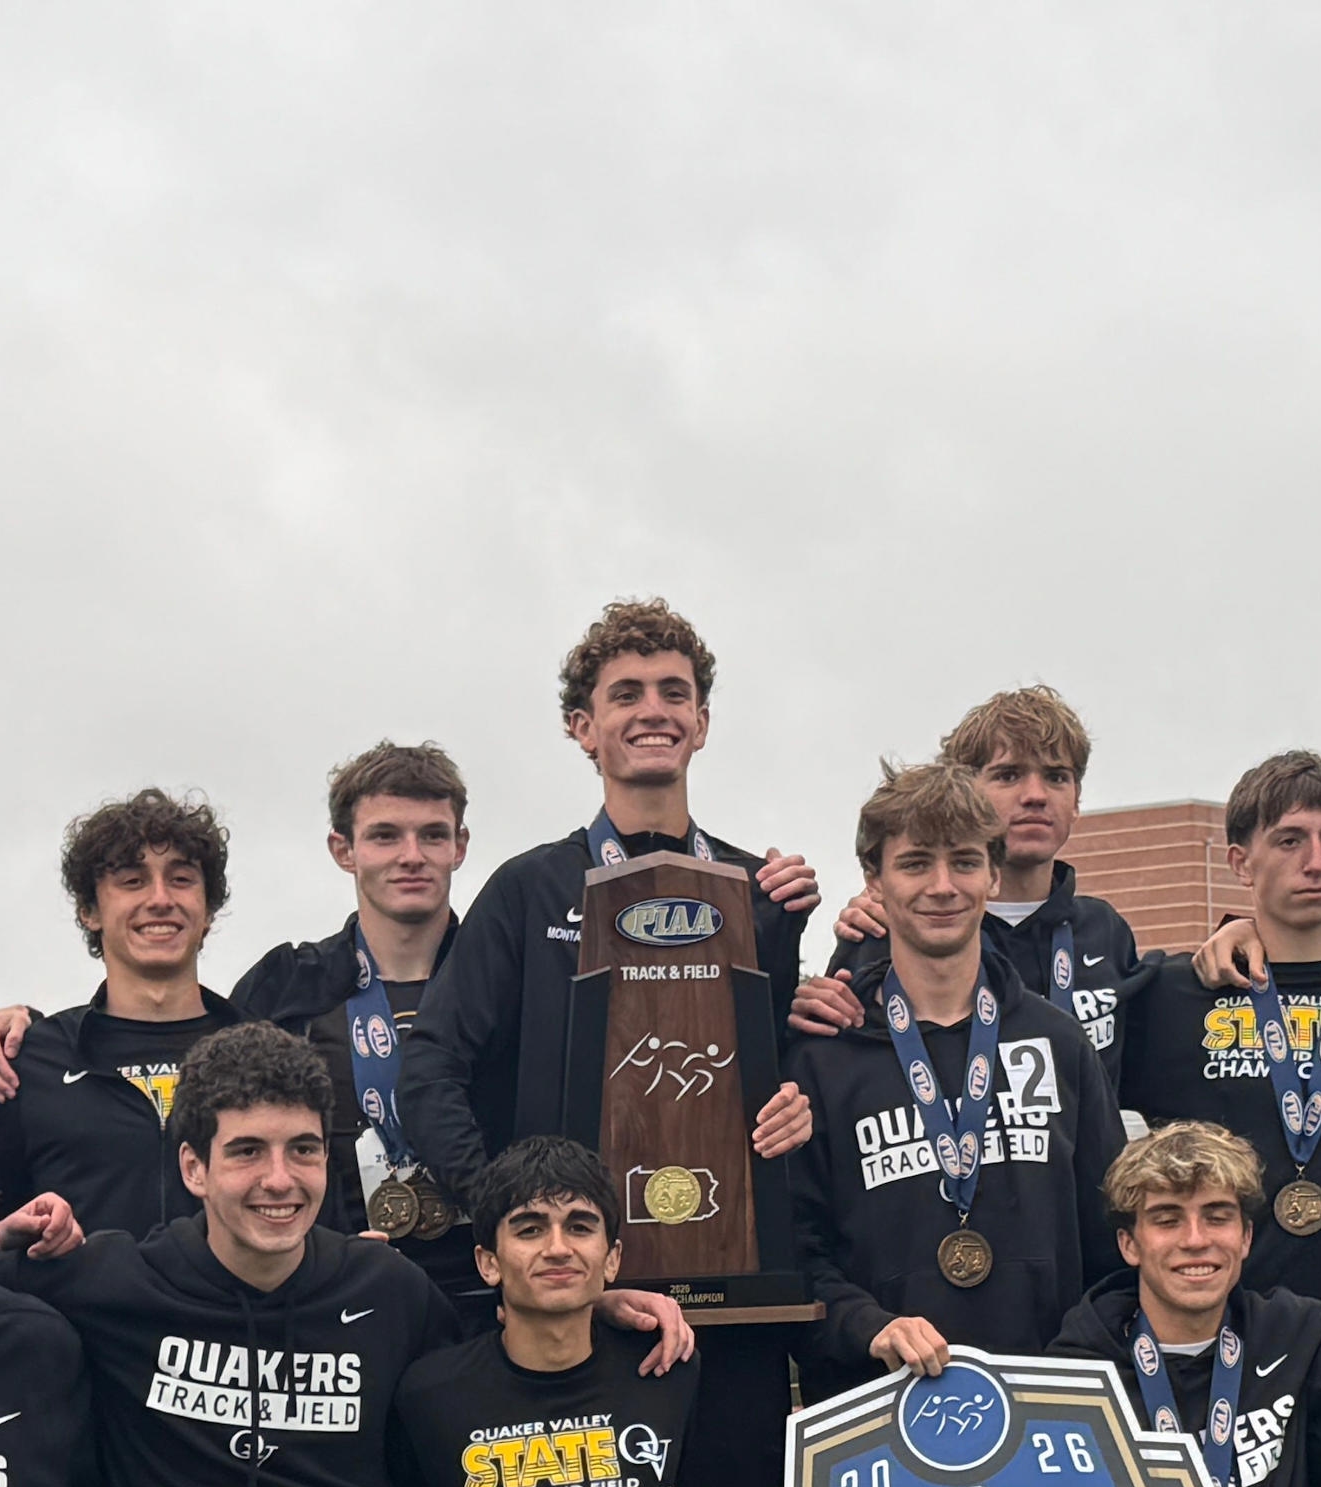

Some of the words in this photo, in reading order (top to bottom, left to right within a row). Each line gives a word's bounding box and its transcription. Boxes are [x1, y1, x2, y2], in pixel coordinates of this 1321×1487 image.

[631, 904, 716, 937] PIAA
[620, 965, 666, 981] TRACK
[669, 965, 680, 979] &
[683, 964, 720, 980] FIELD
[1207, 1050, 1265, 1061] TRACK
[1009, 1043, 1052, 1108] 2
[865, 1146, 931, 1182] TRAC
[675, 1292, 725, 1304] CHAMPION
[155, 1380, 249, 1420] TRACK
[469, 1420, 545, 1443] QUAKER
[548, 1413, 613, 1433] VALLEY
[617, 1423, 673, 1482] QV
[1032, 1432, 1096, 1475] 26
